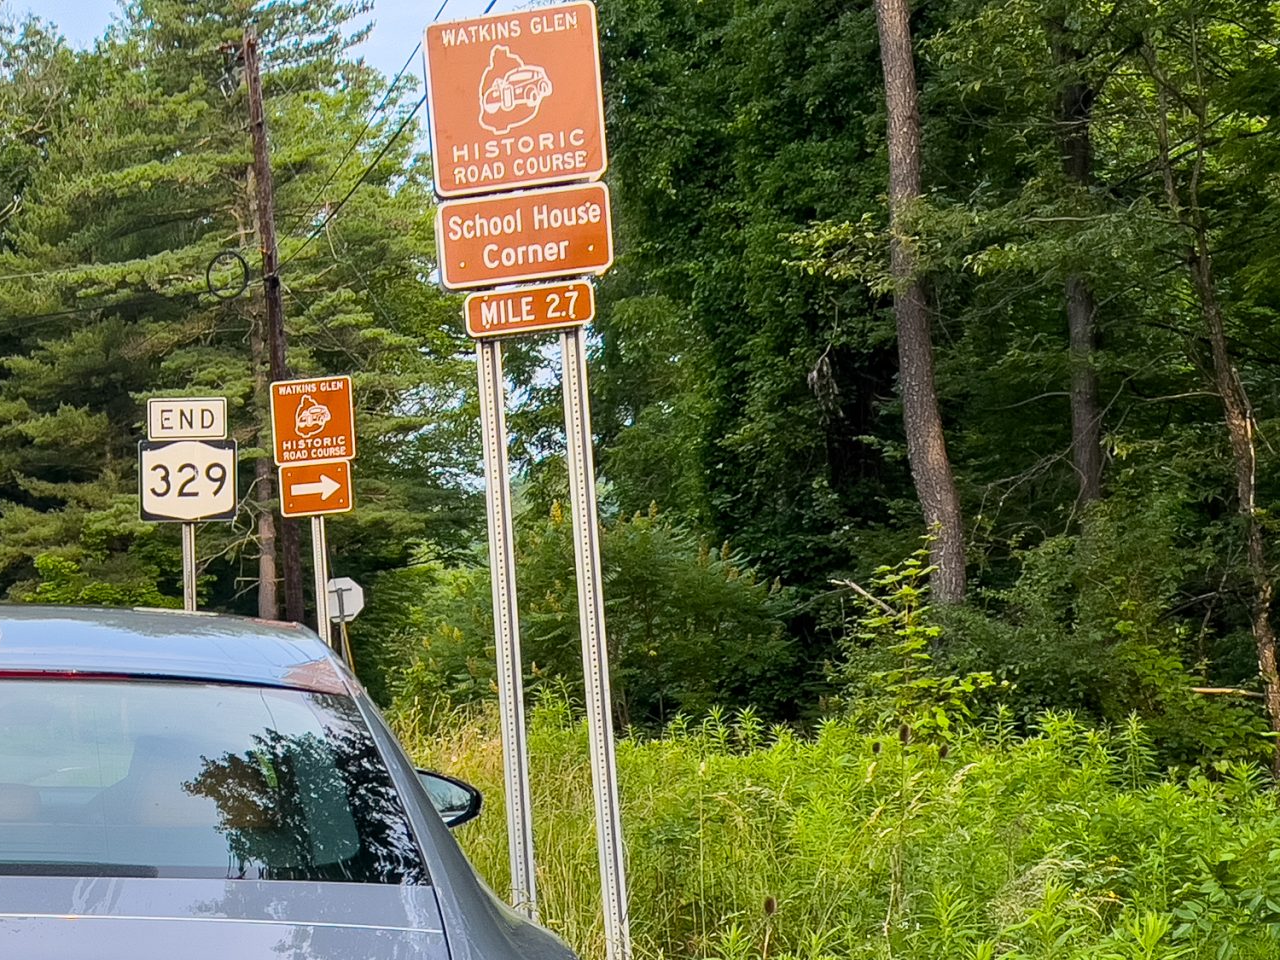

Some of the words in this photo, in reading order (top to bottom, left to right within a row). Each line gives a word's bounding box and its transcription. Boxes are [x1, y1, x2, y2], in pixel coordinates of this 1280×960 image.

[441, 19, 521, 48] WATKINS
[530, 11, 578, 35] GLEN
[452, 128, 585, 163] HISTORIC
[453, 158, 505, 185] ROAD
[513, 150, 587, 177] COURSE
[448, 209, 521, 241] School
[533, 202, 602, 231] House
[483, 240, 569, 269] Corner
[481, 296, 535, 328] MILE
[546, 291, 579, 319] 2.7
[279, 384, 317, 395] WATKINS
[320, 381, 344, 392] GLEN
[161, 408, 215, 430] END
[282, 436, 346, 450] HISTORIC
[283, 450, 308, 460] ROAD
[311, 446, 346, 458] COURSE
[150, 462, 227, 497] 329
